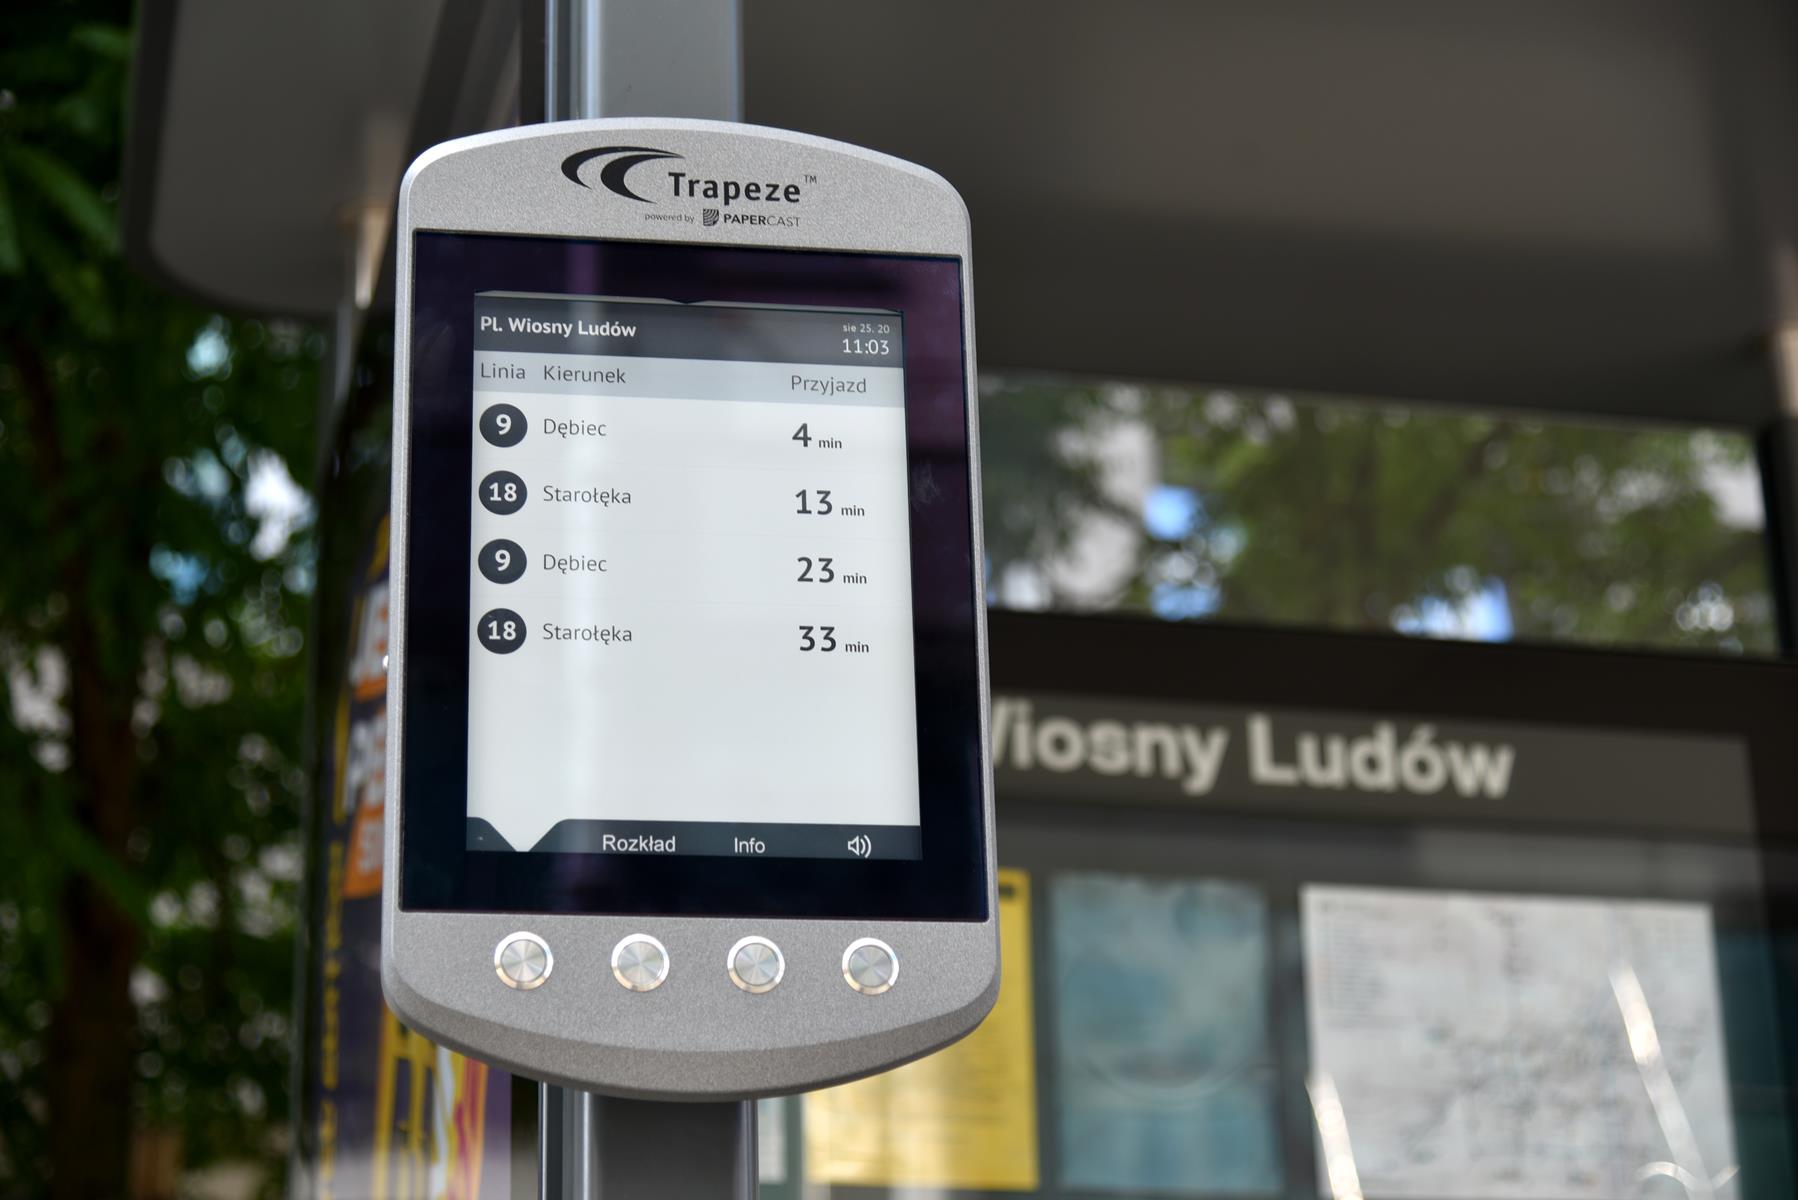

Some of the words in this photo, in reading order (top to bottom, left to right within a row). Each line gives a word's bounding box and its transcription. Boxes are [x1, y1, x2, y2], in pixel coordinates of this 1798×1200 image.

[668, 172, 800, 206] Trapeze
[644, 213, 682, 222] powered
[684, 214, 695, 223] by
[723, 213, 800, 227] PAPERCAST
[480, 316, 503, 332] Pl.
[508, 317, 573, 338] Wiosny
[578, 320, 637, 337] Ludów
[842, 323, 857, 333] sie
[860, 323, 875, 334] 25.
[877, 324, 890, 334] 20
[842, 338, 890, 355] 11:03
[480, 362, 526, 380] Linia
[543, 365, 626, 384] Kierunek
[791, 375, 867, 396] Przyjazd
[495, 413, 512, 435] 9
[543, 418, 607, 438] Dębiec
[792, 422, 812, 447] 4
[818, 437, 842, 449] min
[488, 482, 518, 502] 18
[543, 485, 632, 507] Starołęka
[795, 489, 833, 515] 13
[841, 505, 865, 516] min
[494, 549, 511, 571] 9
[543, 554, 607, 574] Dębiec
[797, 556, 835, 583] 23
[843, 572, 867, 584] min
[487, 620, 517, 641] 18
[542, 623, 632, 645] Starołęka
[799, 625, 837, 652] 33
[845, 641, 869, 653] min
[1247, 713, 1518, 799] Ludów
[601, 833, 676, 854] Rozkład
[734, 837, 766, 855] Info
